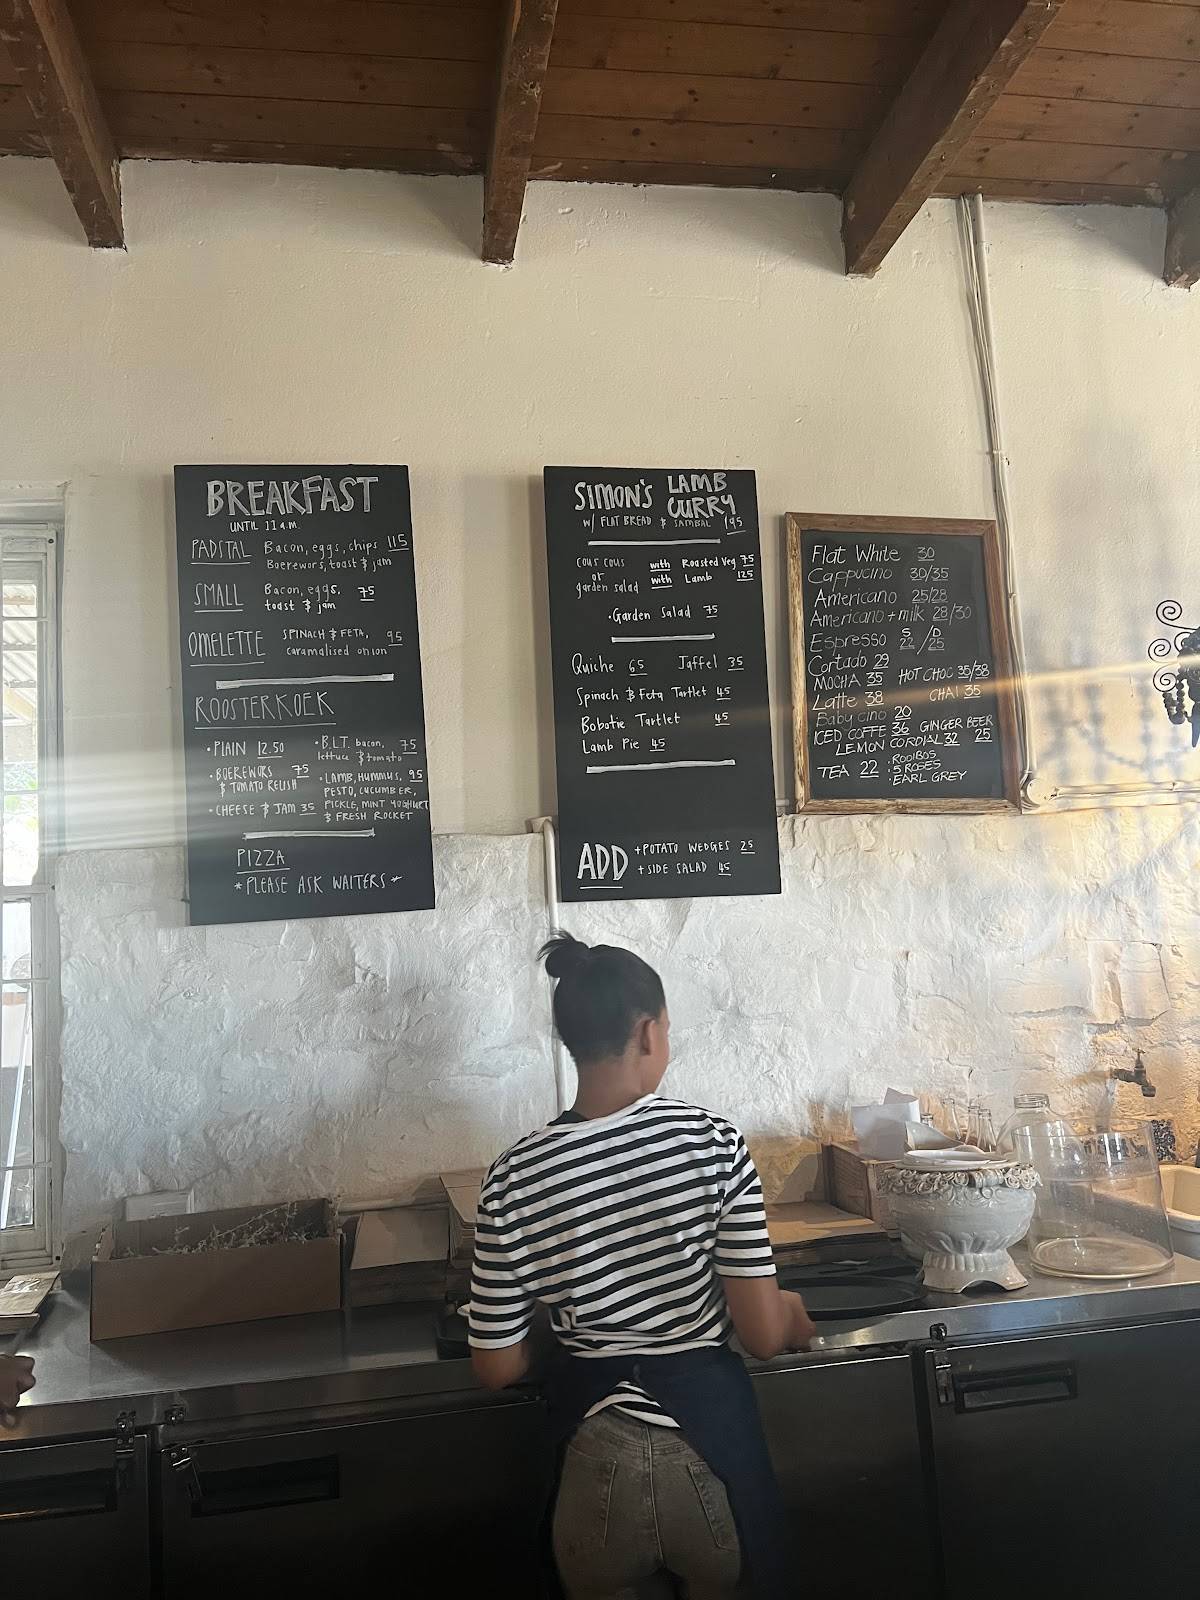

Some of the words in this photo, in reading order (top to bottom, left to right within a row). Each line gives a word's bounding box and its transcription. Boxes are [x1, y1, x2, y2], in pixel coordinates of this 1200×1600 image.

[206, 475, 378, 517] BREAKFAST
[575, 479, 653, 511] SIMON'S
[668, 472, 728, 493] LAMB
[668, 494, 736, 519] CURRY
[230, 521, 259, 532] UNTIL
[265, 520, 277, 531] 11
[601, 516, 619, 527] FLAT
[624, 516, 651, 526] BREAD
[675, 519, 711, 528] SAMBAL
[725, 516, 742, 530] 195
[192, 539, 252, 559] PADSTAL
[264, 541, 308, 555] Bacon,
[349, 540, 377, 552] chips
[387, 534, 408, 547] 115
[811, 545, 846, 564] Flat
[855, 544, 900, 563] White
[918, 547, 935, 558] 30
[267, 559, 327, 572] Boerewors,
[329, 559, 357, 569] toast
[372, 557, 392, 572] jam
[650, 561, 670, 569] with
[682, 558, 718, 568] Roasted
[721, 558, 736, 570] Veg
[592, 573, 605, 581] or
[651, 575, 672, 585] with
[685, 572, 712, 583] Lamb
[808, 567, 892, 592] Cappucino
[910, 565, 949, 580] 30/35
[194, 583, 244, 606] SMALL
[264, 584, 303, 597] Bacon,
[358, 586, 375, 596] 75
[576, 582, 608, 599] garden
[614, 580, 638, 594] salad
[814, 589, 897, 609] Americano
[912, 587, 948, 602] 25/28
[265, 601, 295, 611] toast
[317, 601, 336, 614] jam
[612, 608, 651, 624] Garden
[662, 606, 690, 618] Salad
[703, 605, 717, 614] 75
[810, 609, 884, 628] Americano
[898, 604, 925, 622] milk
[933, 603, 971, 625] 28/30
[283, 629, 325, 640] SPINACH
[387, 630, 402, 643] 95
[902, 628, 910, 637] S
[933, 628, 941, 637] D
[189, 630, 266, 657] OMELETTE
[358, 647, 387, 655] onion
[810, 632, 887, 656] Espresso
[572, 653, 615, 675] Quiche
[629, 659, 644, 672] 65
[678, 654, 717, 670] Jaffel
[728, 657, 743, 667] 35
[808, 653, 867, 676] Cortado
[873, 654, 889, 666] 29
[899, 667, 922, 685] HOT
[923, 668, 953, 681] CHOC
[957, 660, 990, 677] 35/38
[814, 674, 861, 691] MOCHA
[867, 672, 883, 684] 35
[576, 688, 618, 707] Spinach
[639, 689, 663, 700] Feta
[671, 686, 706, 698] Tartlet
[717, 686, 730, 696] 45
[812, 694, 858, 711] Latte
[865, 691, 883, 704] 38
[929, 685, 959, 702] CHAI
[964, 685, 981, 696] 35
[581, 715, 625, 734] Bobotie
[635, 712, 680, 727] Tartlet
[715, 712, 728, 722] 45
[816, 711, 853, 727] Baby
[857, 711, 887, 721] cino
[894, 705, 912, 718] 20
[920, 717, 963, 732] GINGER
[966, 714, 993, 728] BEER
[814, 729, 842, 746] ICED
[848, 725, 886, 740] COFFE
[892, 721, 909, 733] 36
[836, 739, 885, 756] LEMON
[890, 734, 944, 749] CORDIAL
[944, 732, 959, 743] 32
[975, 728, 991, 739] 25
[214, 741, 246, 756] PLAIN
[258, 741, 284, 755] 12.50
[400, 739, 416, 750] 75
[583, 739, 613, 754] Lamb
[623, 737, 640, 750] Pie
[652, 738, 665, 748] 45
[318, 752, 349, 761] lettuce
[366, 753, 402, 761] tomato
[892, 750, 937, 764] ROOIBOS
[216, 765, 272, 781] BOEREWORS
[292, 764, 309, 773] 75
[409, 770, 422, 779] 95
[817, 765, 850, 779] TEA
[860, 760, 878, 774] 22
[893, 764, 901, 773] 5
[904, 760, 941, 772] ROSES
[230, 782, 263, 792] TOMATO
[268, 779, 297, 791] RELISH
[892, 775, 927, 786] EARL
[932, 770, 968, 782] GREY
[324, 787, 356, 797] PESTO,
[216, 805, 255, 816] CHEESE
[275, 804, 295, 815] JAM
[300, 803, 315, 811] 35
[325, 800, 359, 810] PICKLE,
[361, 800, 385, 808] MINT
[336, 812, 366, 821] FRESH
[374, 812, 413, 820] ROCKET
[689, 841, 730, 853] WEDGES
[740, 840, 753, 851] 25
[237, 849, 285, 866] PIZZA
[577, 843, 629, 880] ADD
[677, 862, 707, 874] SALAD
[719, 862, 730, 872] 45
[298, 876, 323, 893] ASK
